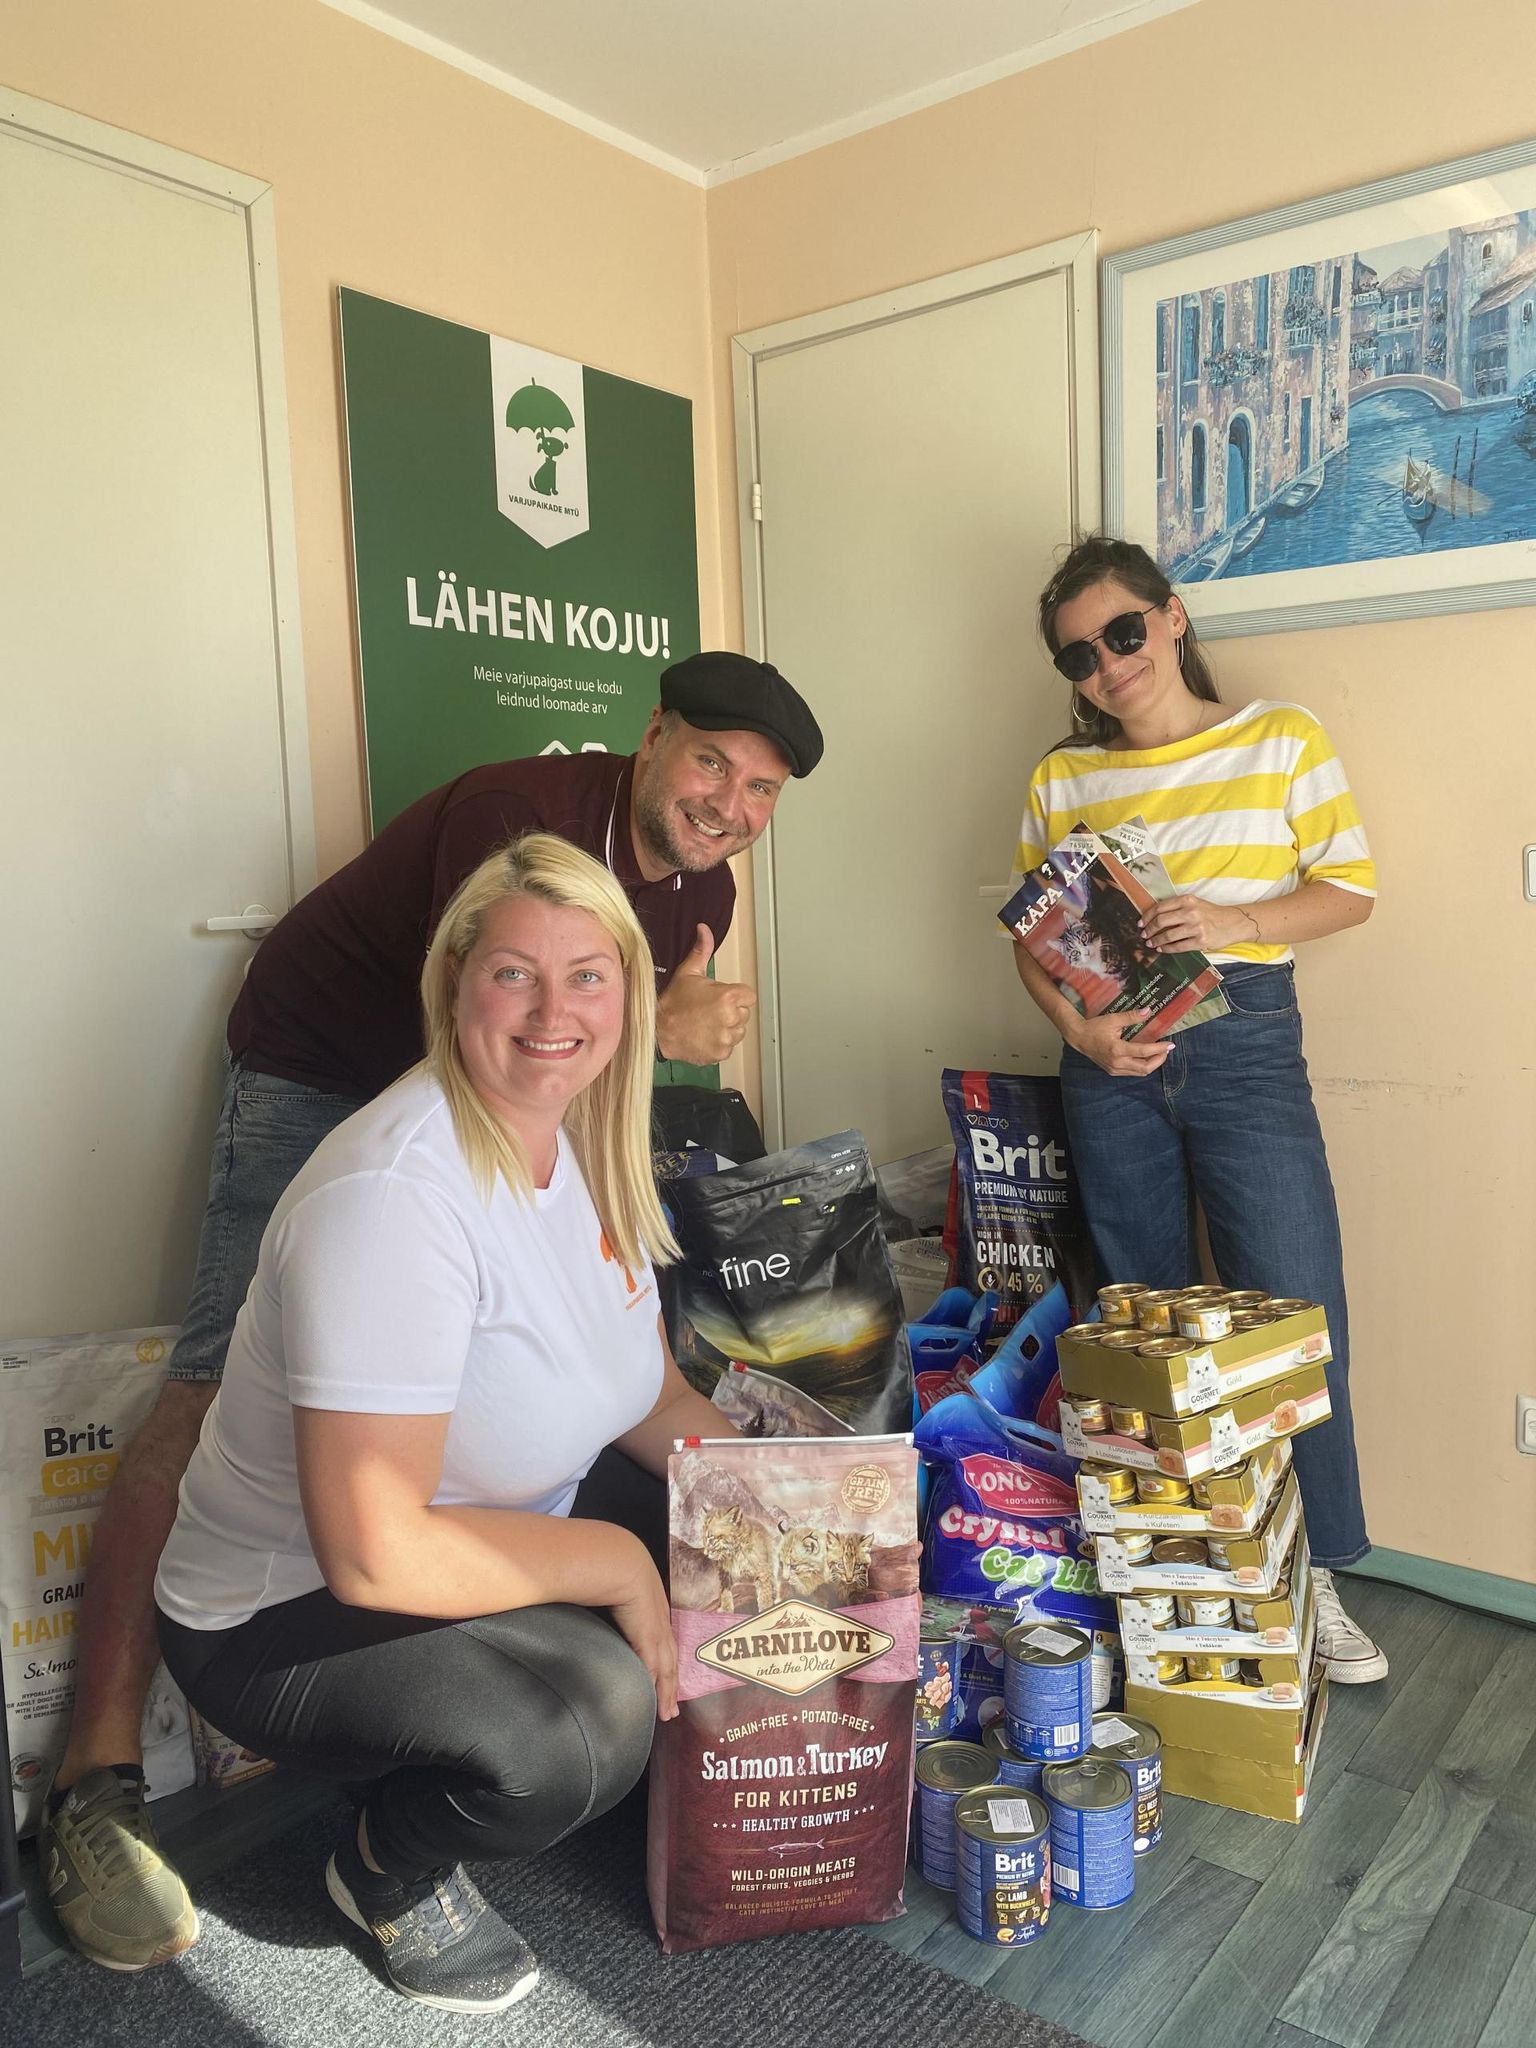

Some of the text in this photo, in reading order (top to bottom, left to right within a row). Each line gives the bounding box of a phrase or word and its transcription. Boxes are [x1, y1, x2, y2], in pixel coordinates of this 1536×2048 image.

[508, 494, 579, 517] VARJUPAIKADE MTÜ
[406, 570, 670, 660] LÄHEN KOJU!
[473, 665, 623, 695] Meie varjupaigast uue kodu
[496, 690, 608, 714] leidnud loomade arv
[1120, 832, 1144, 846] TASUTA
[1015, 887, 1063, 937] KÄPA
[973, 1094, 982, 1109] L
[969, 1128, 1067, 1180] Brit
[974, 1181, 1018, 1198] PREMIUM
[1029, 1189, 1069, 1203] NATURE
[994, 1231, 1002, 1240] IN
[976, 1240, 1056, 1269] CHICKEN
[719, 1253, 791, 1291] fine
[1007, 1271, 1044, 1294] 45 %
[1191, 1375, 1242, 1404] GOURMET Gold
[44, 1423, 113, 1457] Brit
[1214, 1433, 1261, 1463] GOURMET Gold
[52, 1463, 109, 1488] care
[849, 1475, 885, 1489] GRAIN
[967, 1471, 1032, 1493] LONG
[847, 1486, 883, 1501] FREE
[940, 1506, 1065, 1550] Crystal
[981, 1546, 1045, 1587] Cat
[715, 1630, 870, 1662] CARNILOVE
[756, 1656, 836, 1676] into the Wild
[726, 1709, 870, 1743] GRAIN-FREE POTATO-FREE
[701, 1751, 794, 1781] Salmon
[734, 1781, 858, 1808] FOR KITTENS
[742, 1809, 851, 1832] HEALTHY GROWTH
[731, 1856, 856, 1881] WILD-ORIGIN MEATS
[995, 1852, 1035, 1872] Brit
[731, 1884, 760, 1892] FOREST
[762, 1882, 791, 1891] FRUITS,
[793, 1876, 823, 1888] VEGGIES
[832, 1871, 855, 1881] HERBS
[725, 1902, 760, 1910] BALANCED
[761, 1900, 790, 1908] HOLISTIC
[791, 1896, 822, 1904] FORMULA
[759, 1906, 799, 1915] INSTINCTIVE
[800, 1903, 818, 1911] LOVE
[829, 1897, 846, 1906] MEAT
[1008, 1891, 1027, 1902] LAMB
